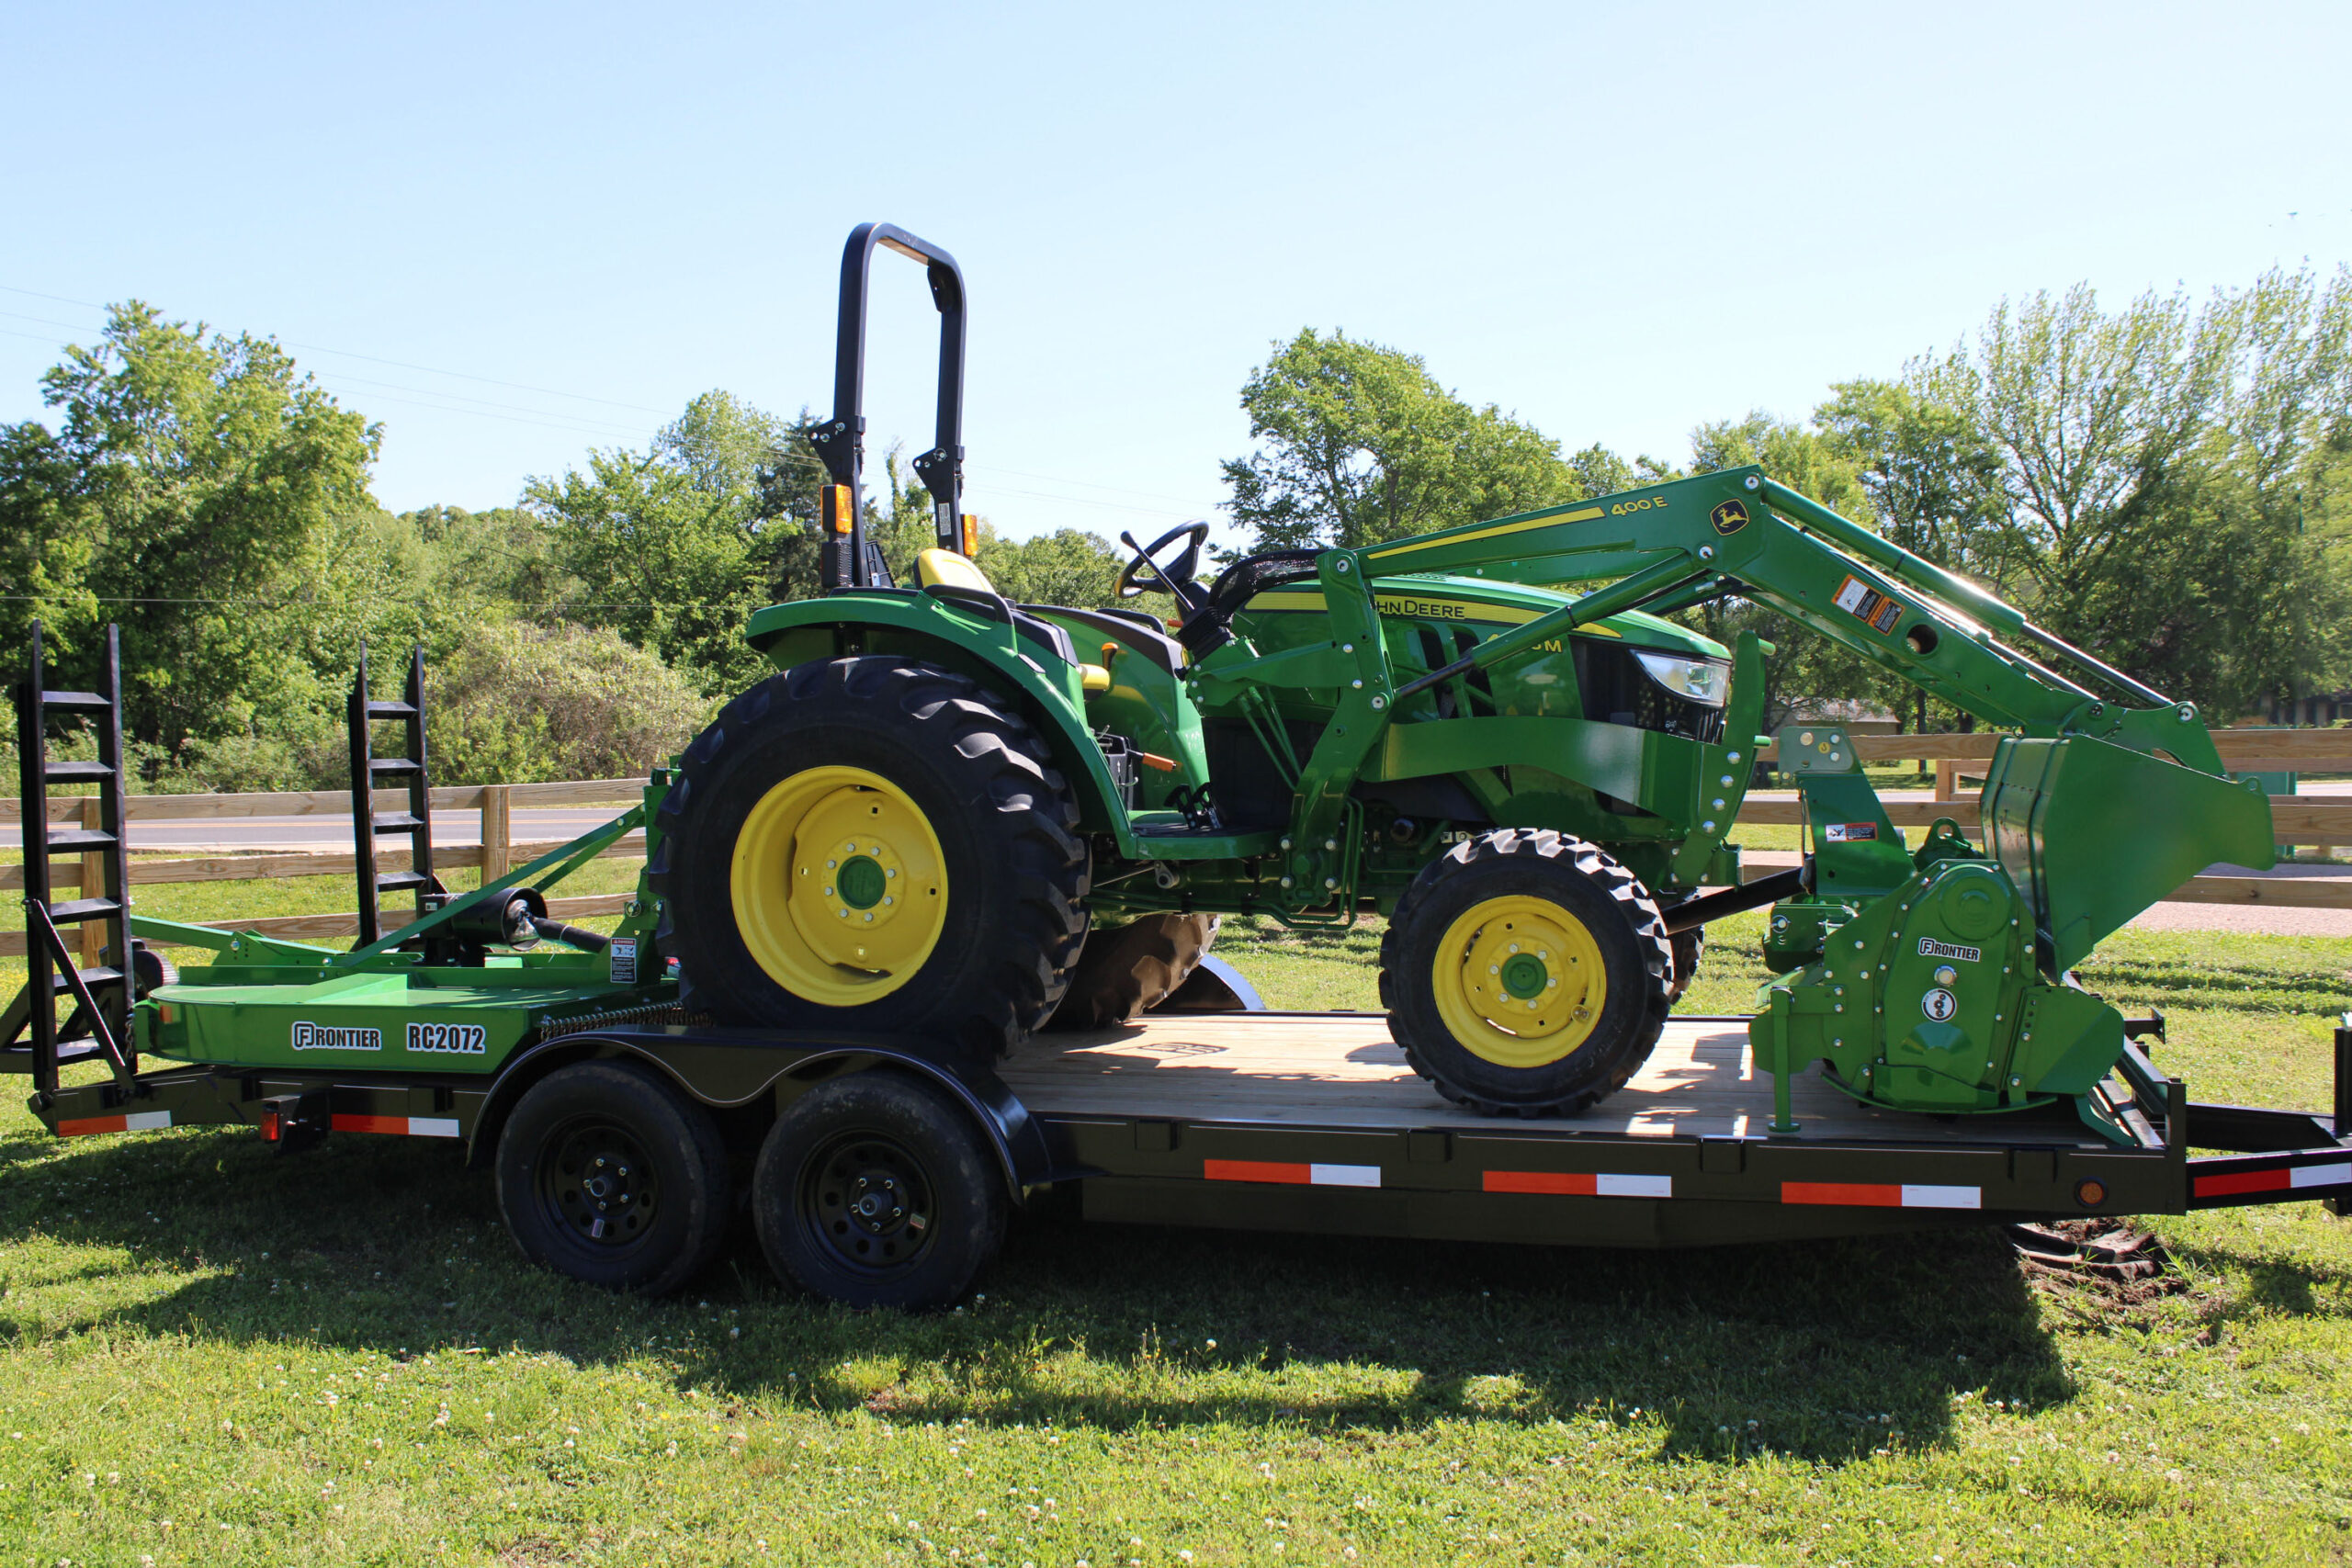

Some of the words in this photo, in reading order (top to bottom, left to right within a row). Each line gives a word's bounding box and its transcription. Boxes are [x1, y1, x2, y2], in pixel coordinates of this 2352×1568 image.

[1376, 601, 1400, 613] HN
[1404, 600, 1465, 618] DEERE
[1919, 937, 1980, 962] FRONTIER
[293, 1021, 381, 1049] FRONTIER
[407, 1024, 484, 1053] RC2072
